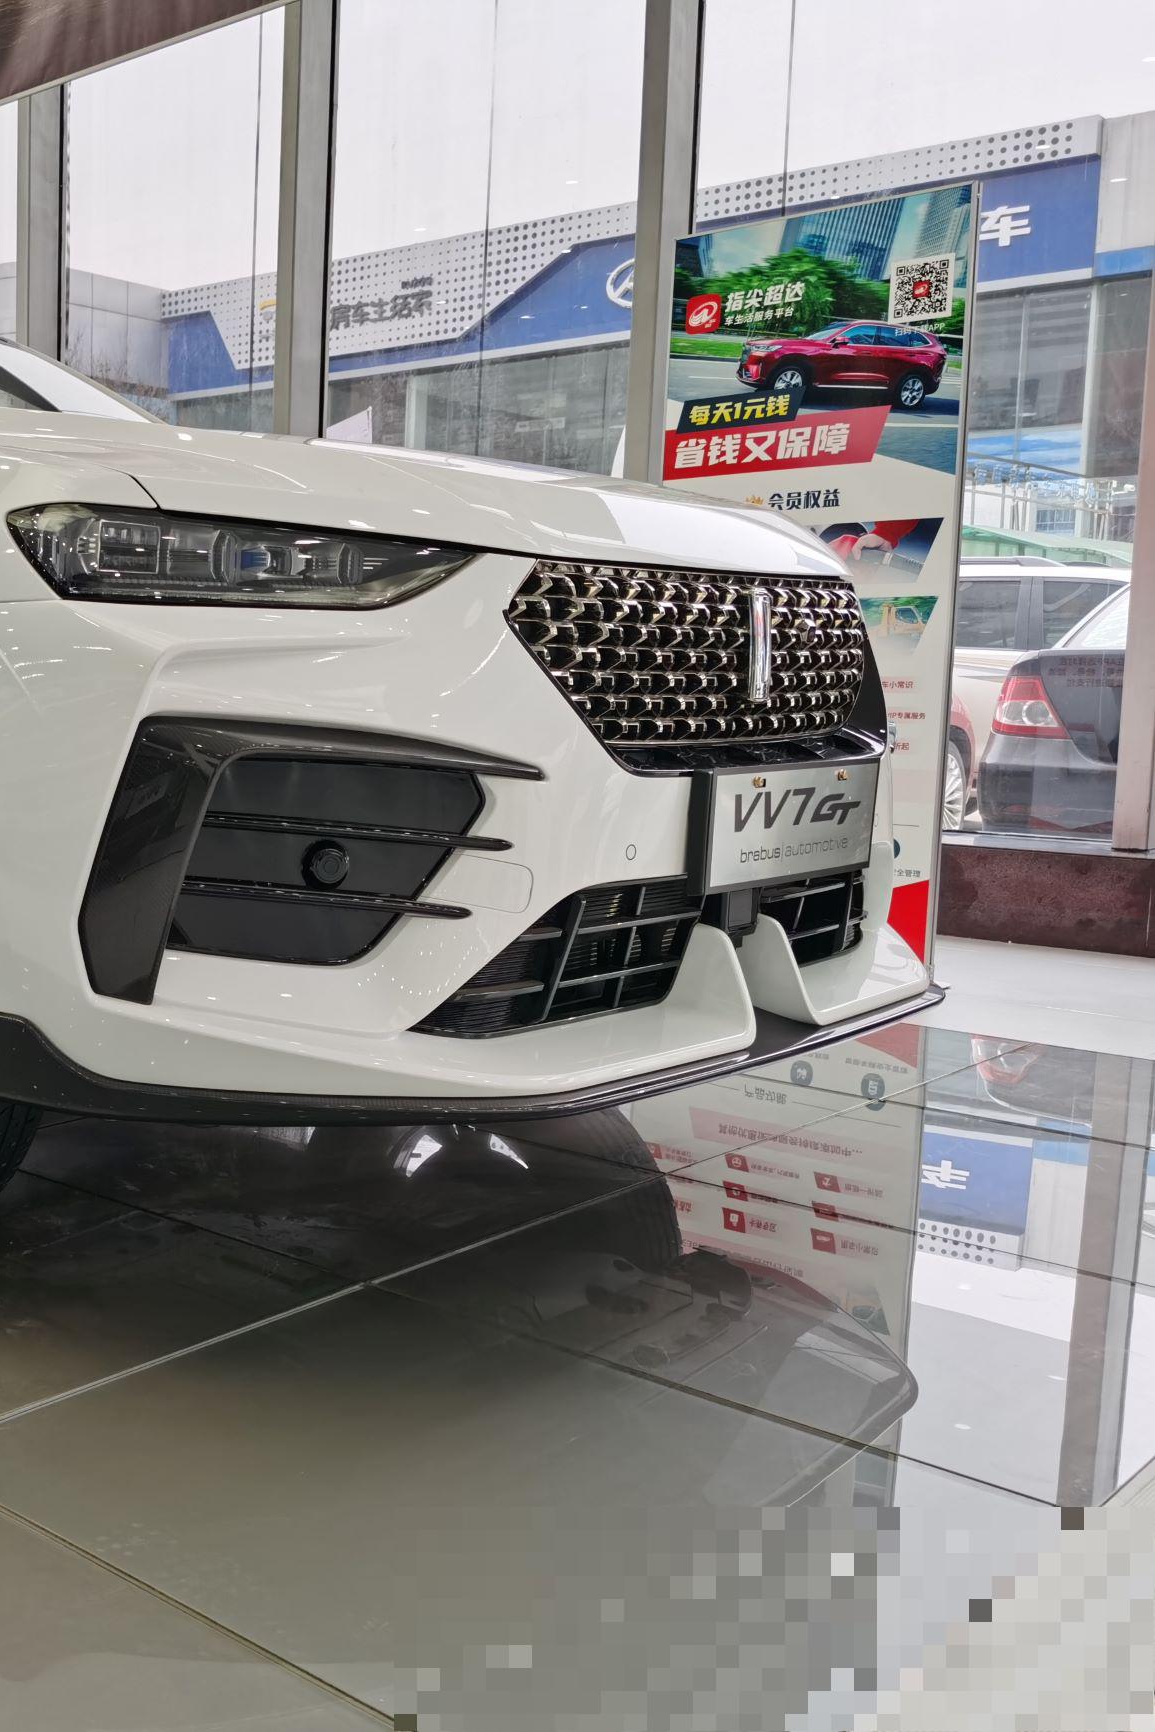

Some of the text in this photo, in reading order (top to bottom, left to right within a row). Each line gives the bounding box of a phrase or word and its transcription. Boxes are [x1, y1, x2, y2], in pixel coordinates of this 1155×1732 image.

[979, 205, 1031, 247] 车
[724, 281, 806, 312] 指尖超达
[724, 306, 795, 326] 车生活服务平台
[688, 394, 790, 426] 每天1元钱
[674, 422, 850, 469] 省钱又保障
[767, 488, 841, 511] 会员权益
